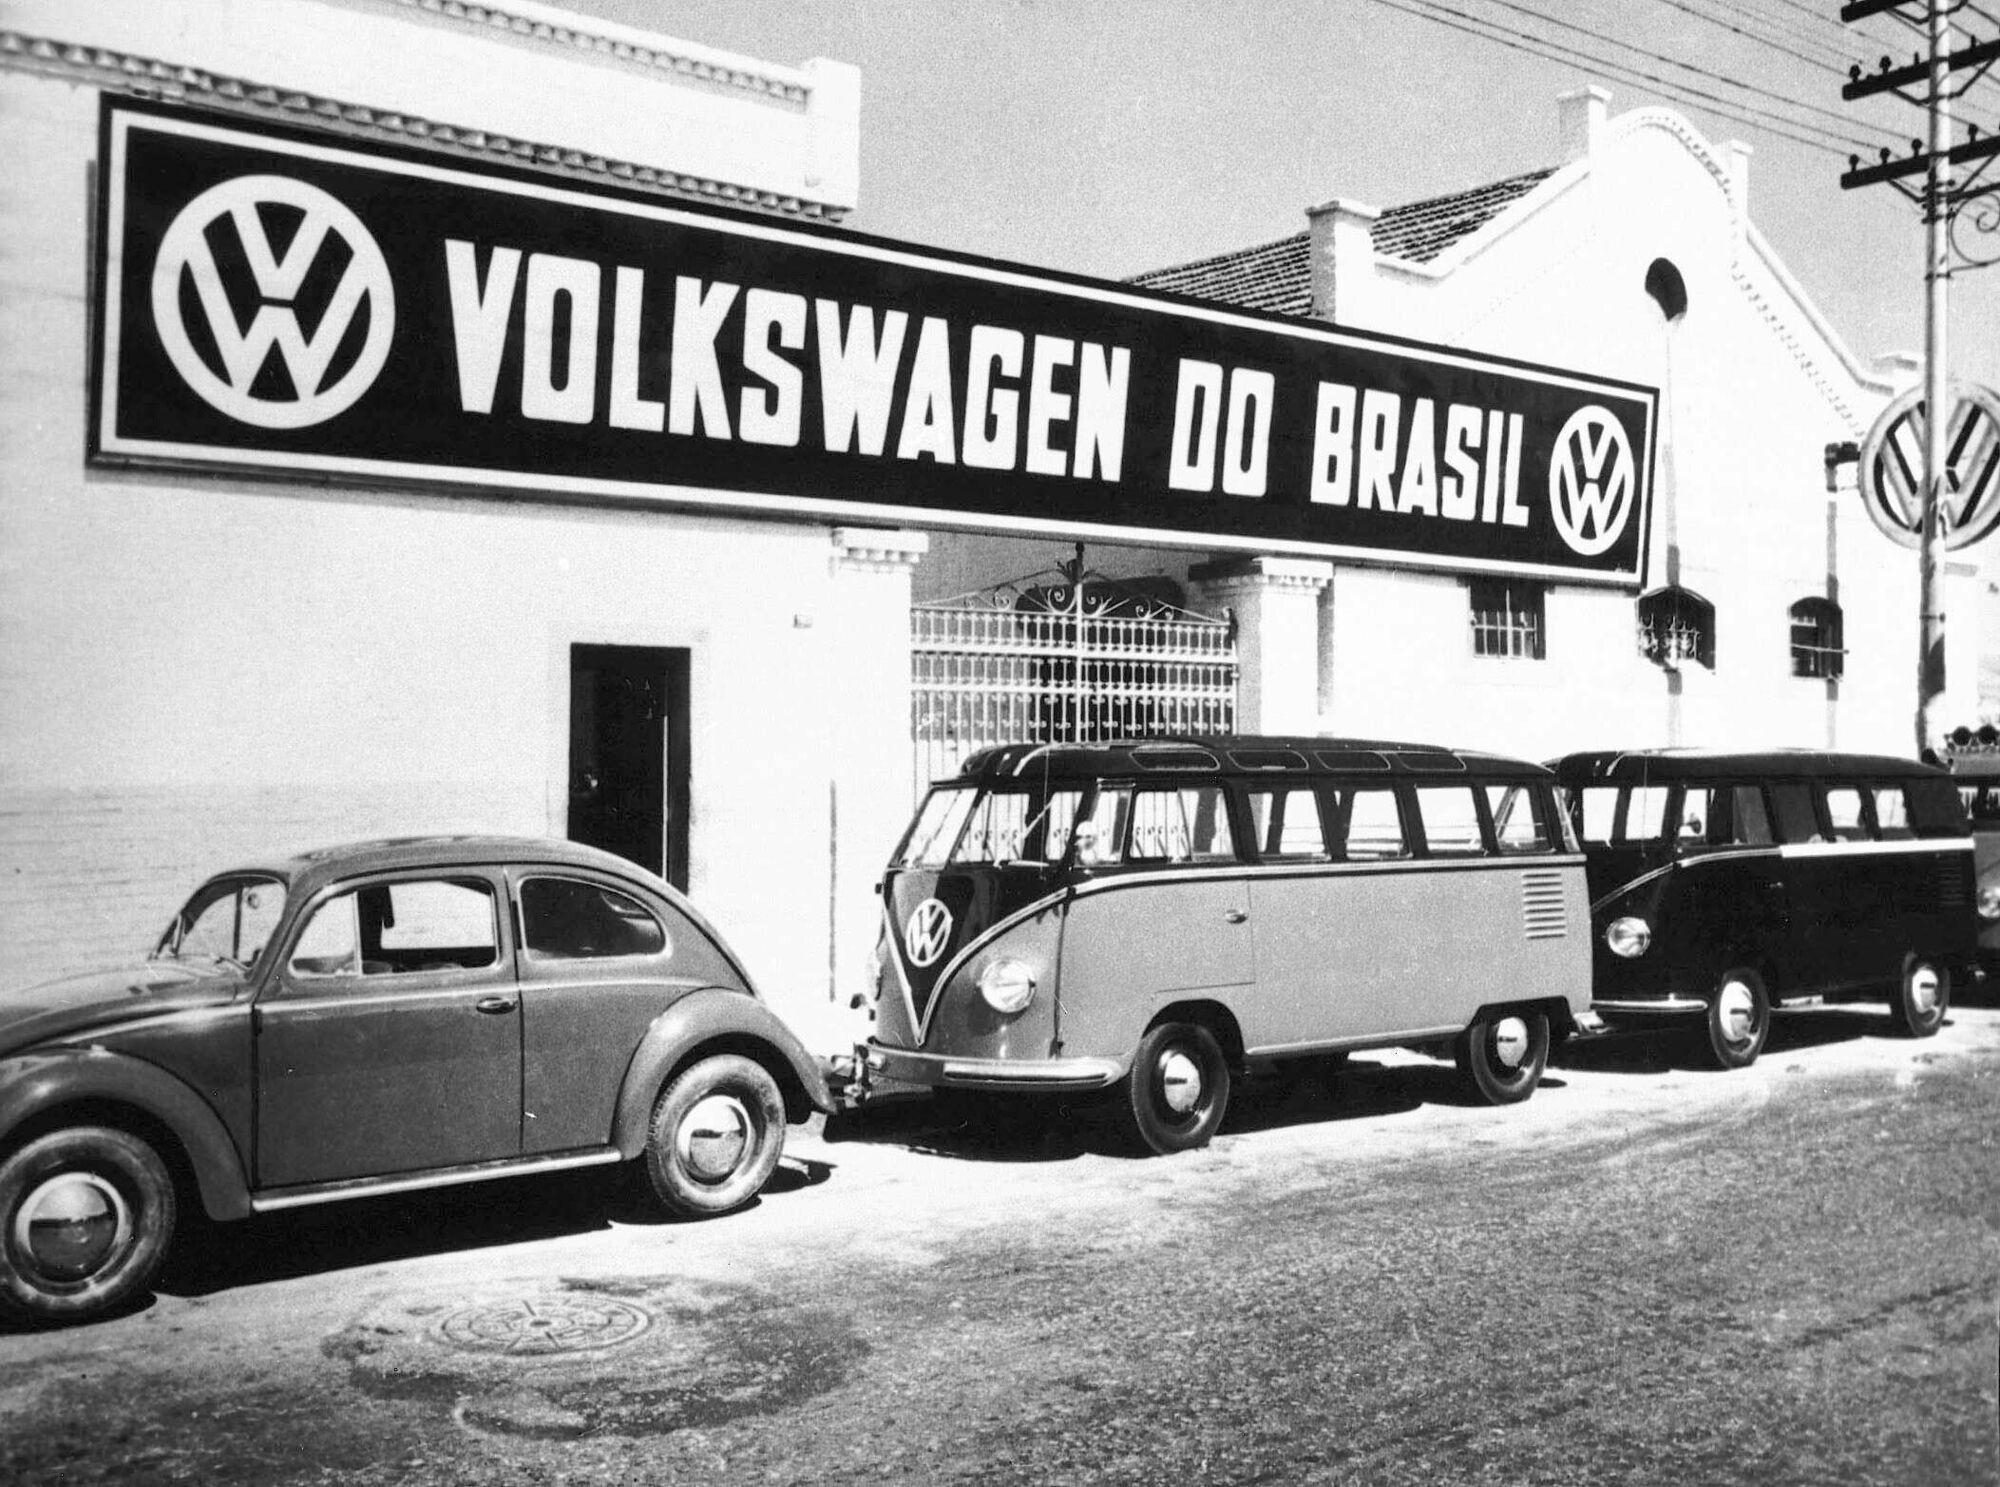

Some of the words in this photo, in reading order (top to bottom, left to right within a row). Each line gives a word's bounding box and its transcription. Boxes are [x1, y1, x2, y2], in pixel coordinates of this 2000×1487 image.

[168, 189, 380, 416] VW
[445, 239, 1130, 482] VOLKSWAGEN
[1169, 359, 1275, 497] DO
[1311, 381, 1530, 526] BRASIL
[1554, 414, 1630, 547] VW
[908, 901, 951, 965] VW
